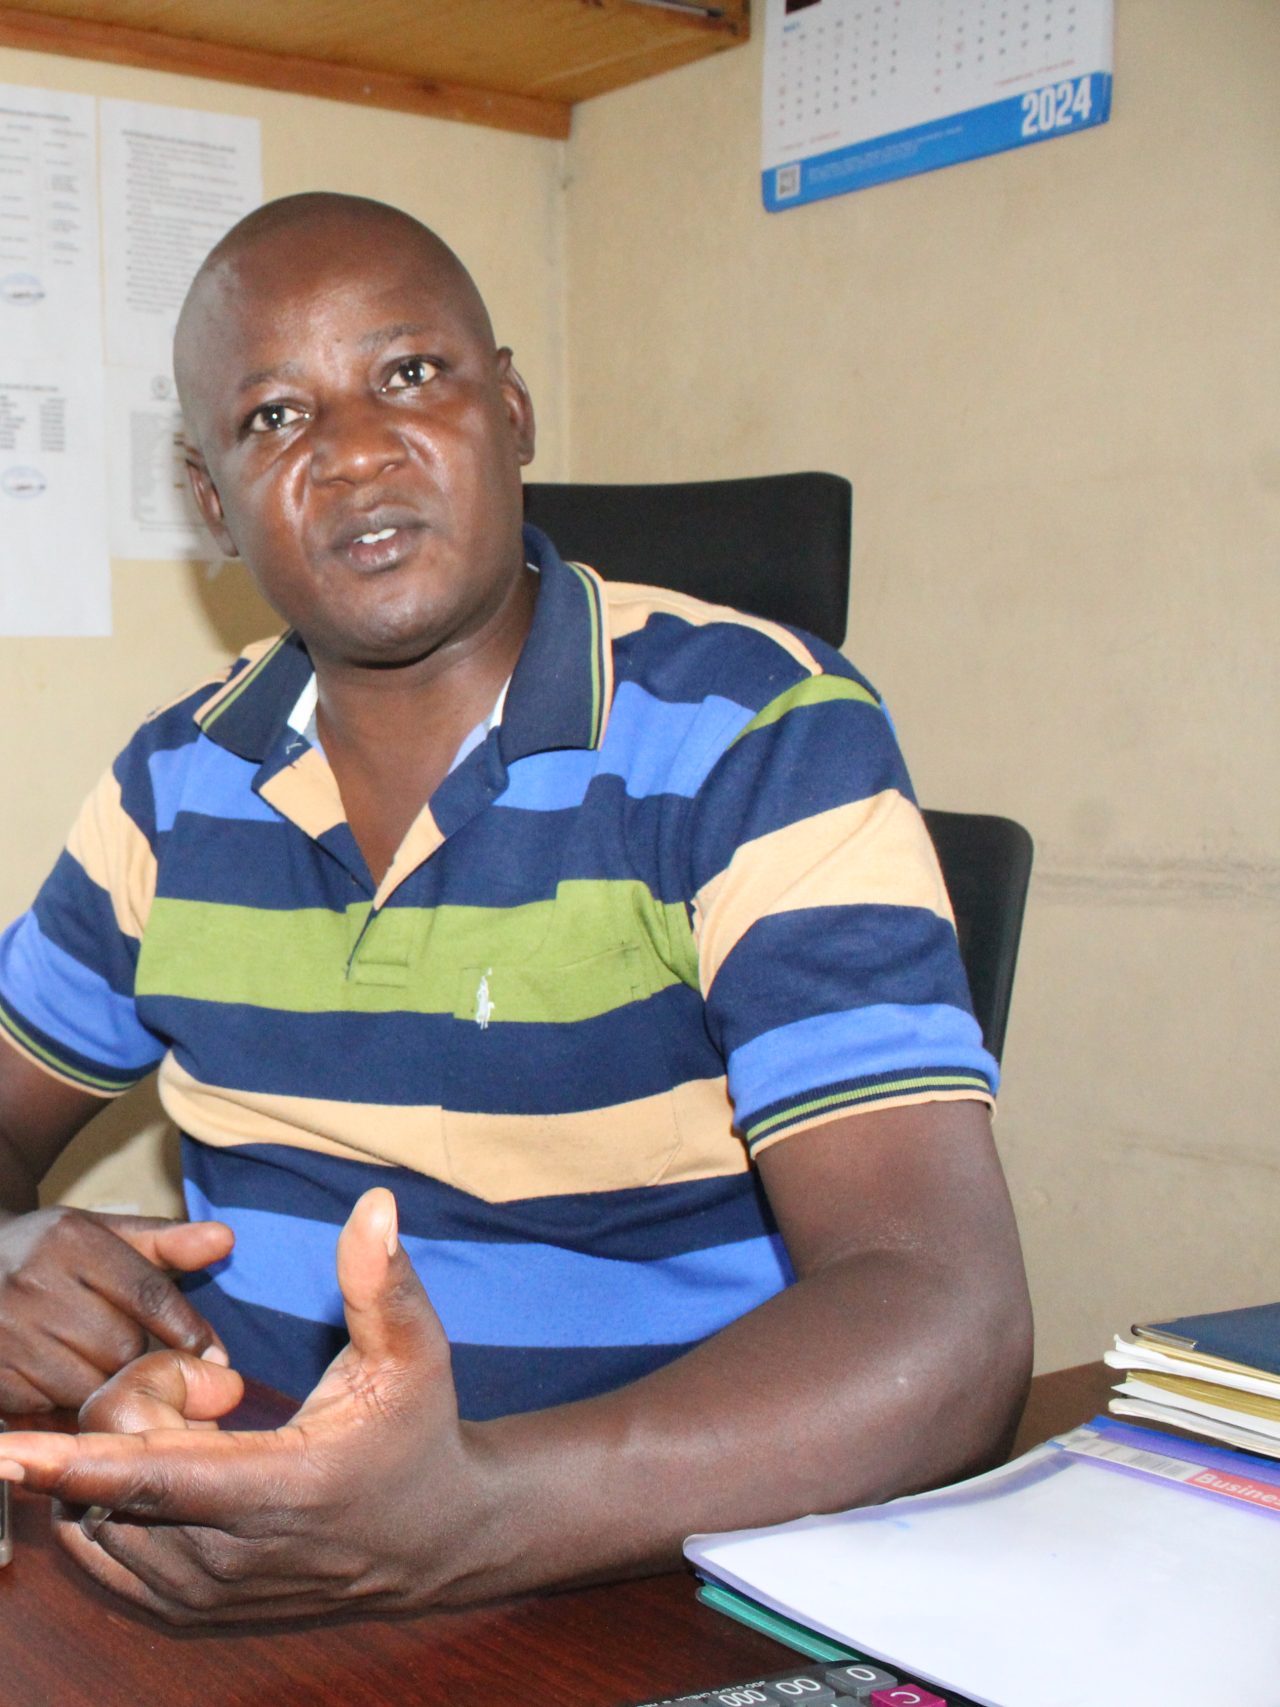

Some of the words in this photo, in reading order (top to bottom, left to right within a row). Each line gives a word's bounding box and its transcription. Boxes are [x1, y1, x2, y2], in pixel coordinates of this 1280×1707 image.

[1022, 76, 1092, 137] 2024
[846, 1667, 876, 1681] 0
[775, 1678, 821, 1695] 00
[718, 1689, 767, 1707] 000
[890, 1691, 921, 1704] C
